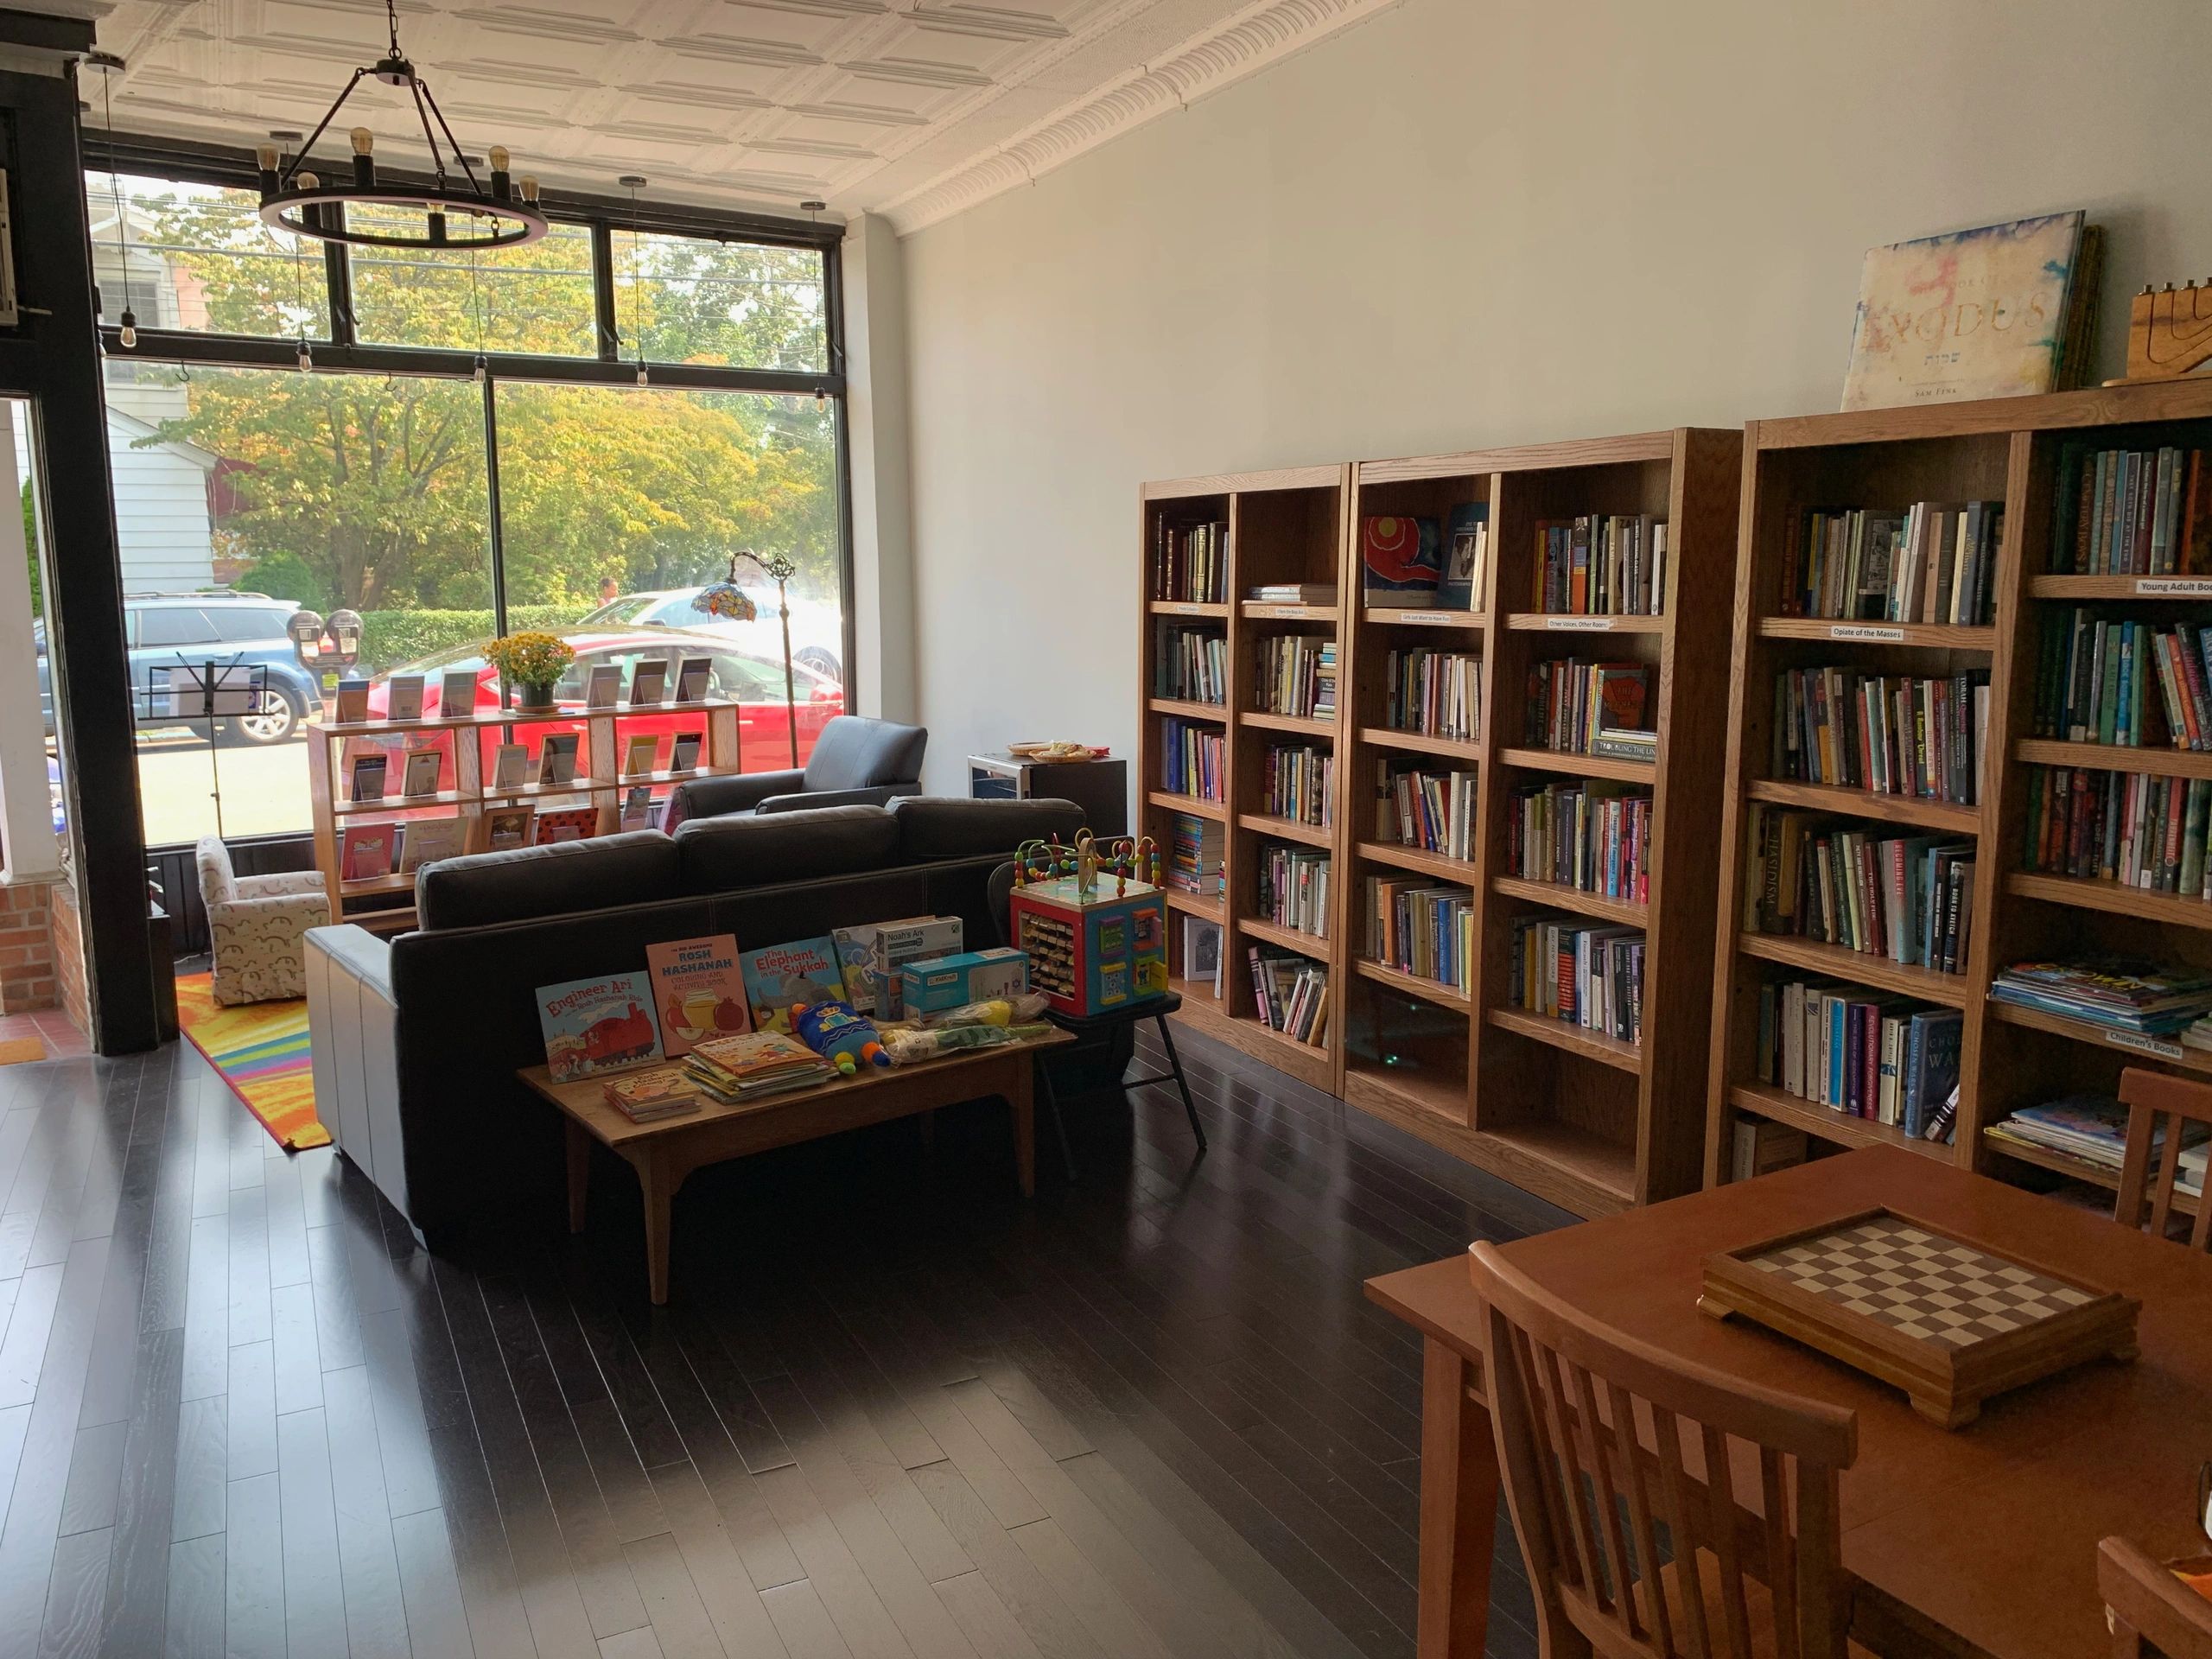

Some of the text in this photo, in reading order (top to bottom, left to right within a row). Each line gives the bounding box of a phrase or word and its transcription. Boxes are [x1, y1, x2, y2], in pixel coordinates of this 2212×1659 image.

[1860, 291, 2049, 353] EXODUS
[2141, 582, 2169, 592] Young
[2171, 582, 2195, 591] Adult
[1834, 627, 1854, 637] Opiate
[1876, 630, 1901, 639] Masses
[1766, 838, 1779, 904] HASIDISM
[887, 929, 925, 942] Noah's Ark
[678, 950, 711, 962] ROSH
[755, 950, 815, 970] Elephant
[766, 950, 782, 959] The
[662, 958, 733, 976] HASHANAH
[783, 956, 829, 975] Sukkah
[671, 973, 707, 984] COLORING
[705, 977, 728, 987] BOOK
[546, 983, 608, 1018] Engineer
[611, 978, 633, 995] Ari
[577, 994, 644, 1011] Rosh Hashanah Ride
[2110, 1032, 2180, 1056] Children's Books
